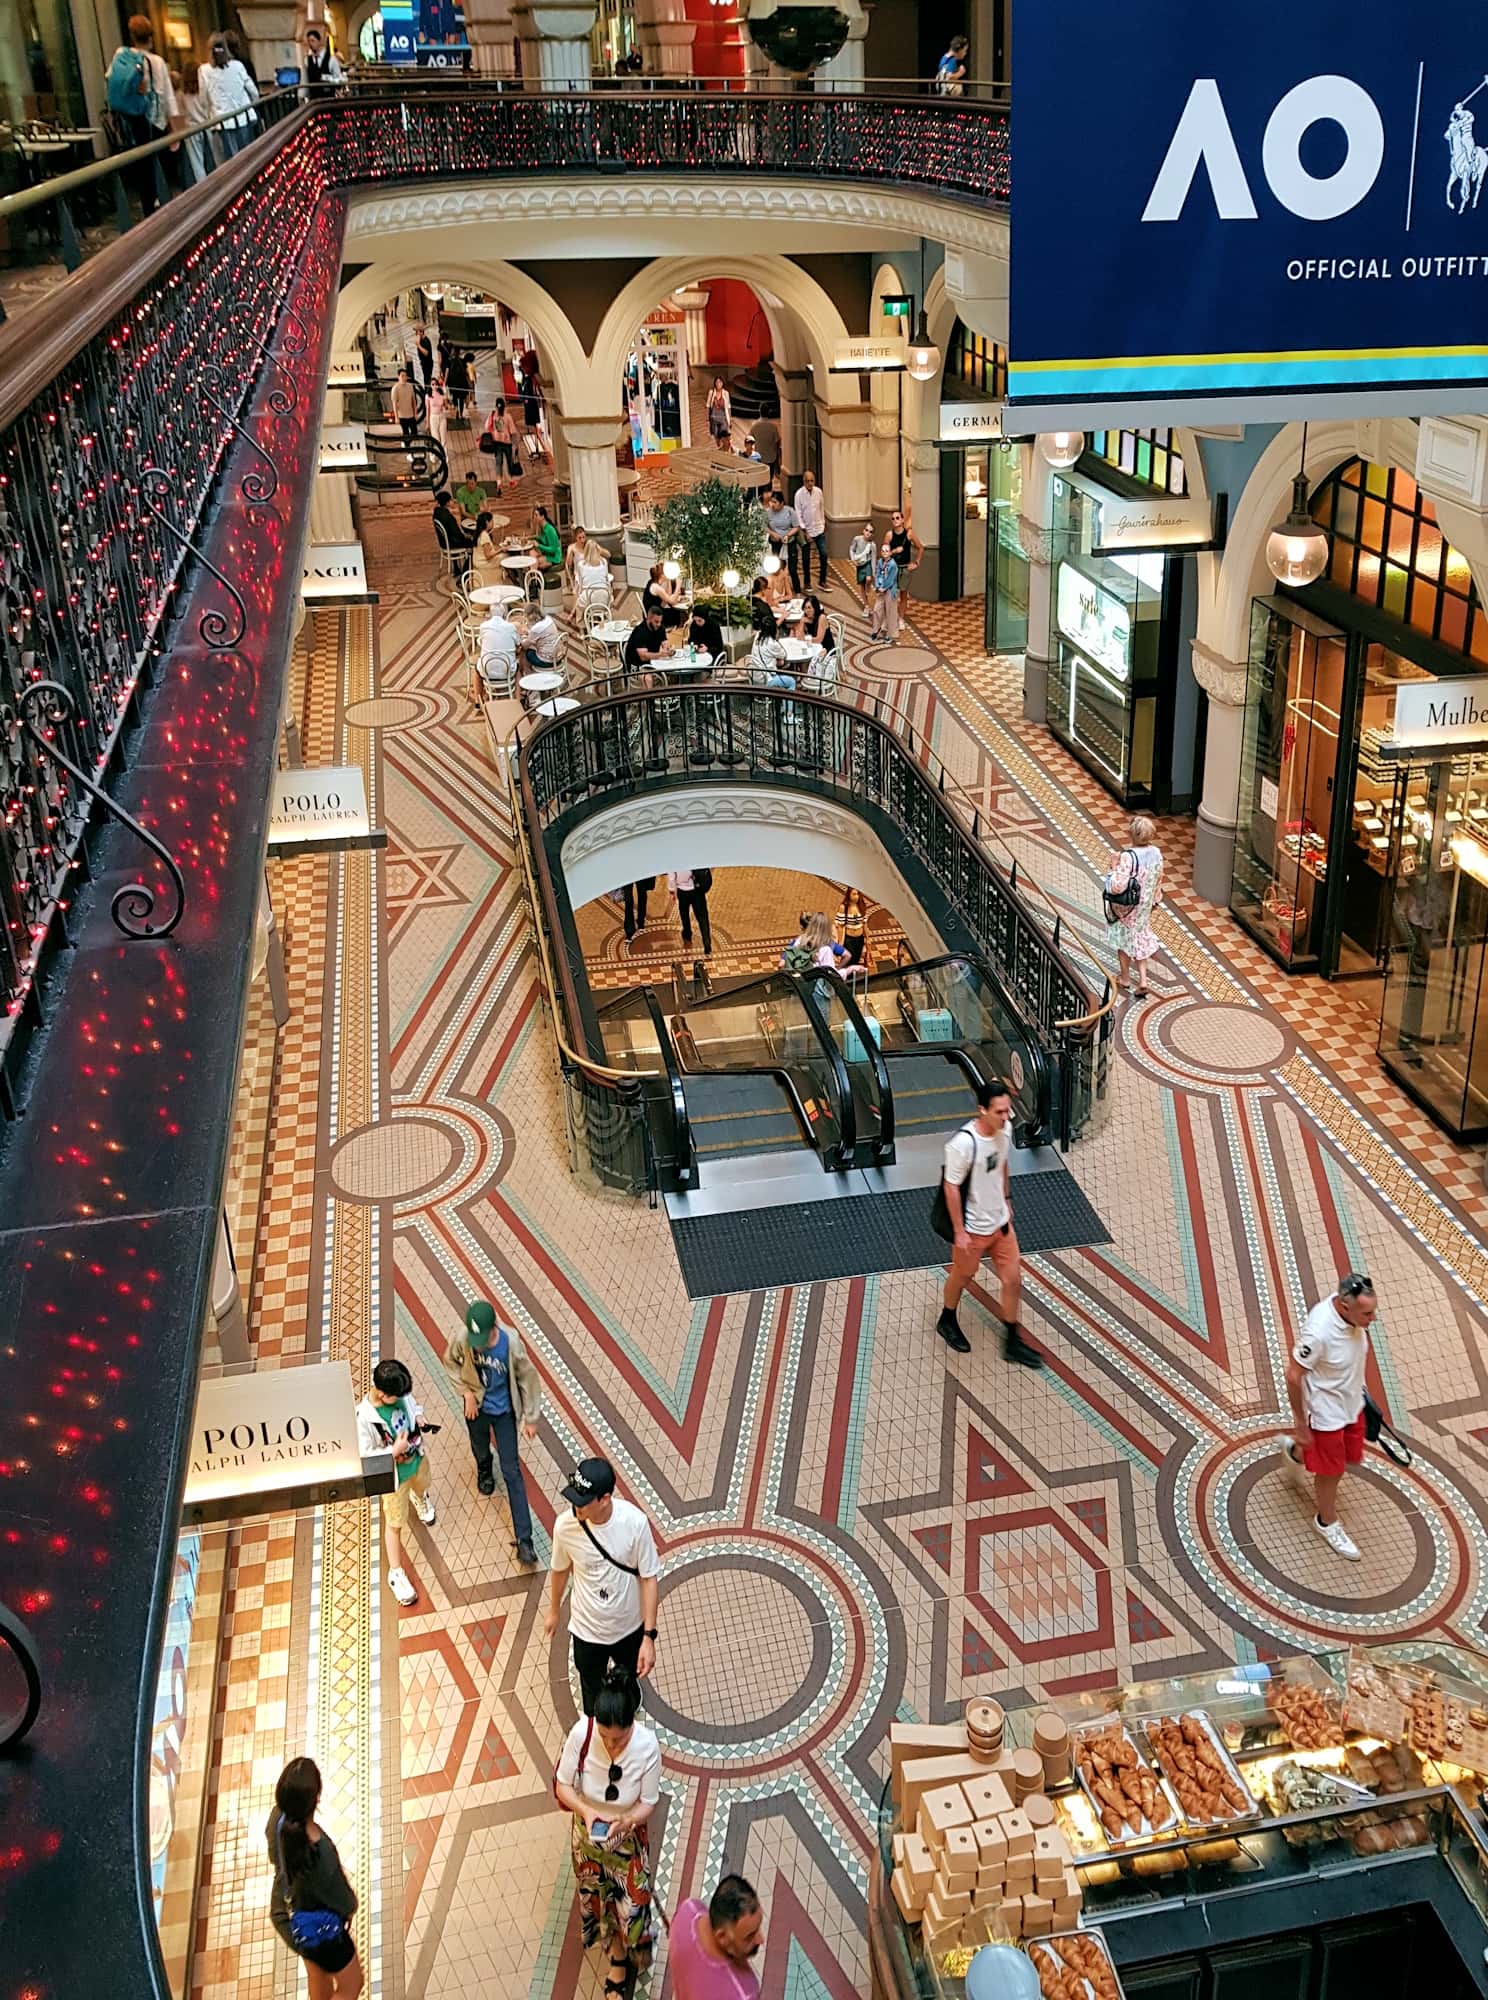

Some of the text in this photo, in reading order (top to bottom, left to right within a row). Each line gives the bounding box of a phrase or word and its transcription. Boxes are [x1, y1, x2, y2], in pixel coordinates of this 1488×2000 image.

[390, 35, 409, 48] AO
[427, 54, 447, 67] AO
[1141, 74, 1385, 221] AO
[1286, 256, 1488, 280] OFFICIAL OUTFITT
[1426, 696, 1488, 727] Mulbe
[282, 792, 341, 812] POLO
[313, 809, 360, 821] LAUREN
[203, 1416, 310, 1454] POLO
[261, 1439, 344, 1463] LAUREN
